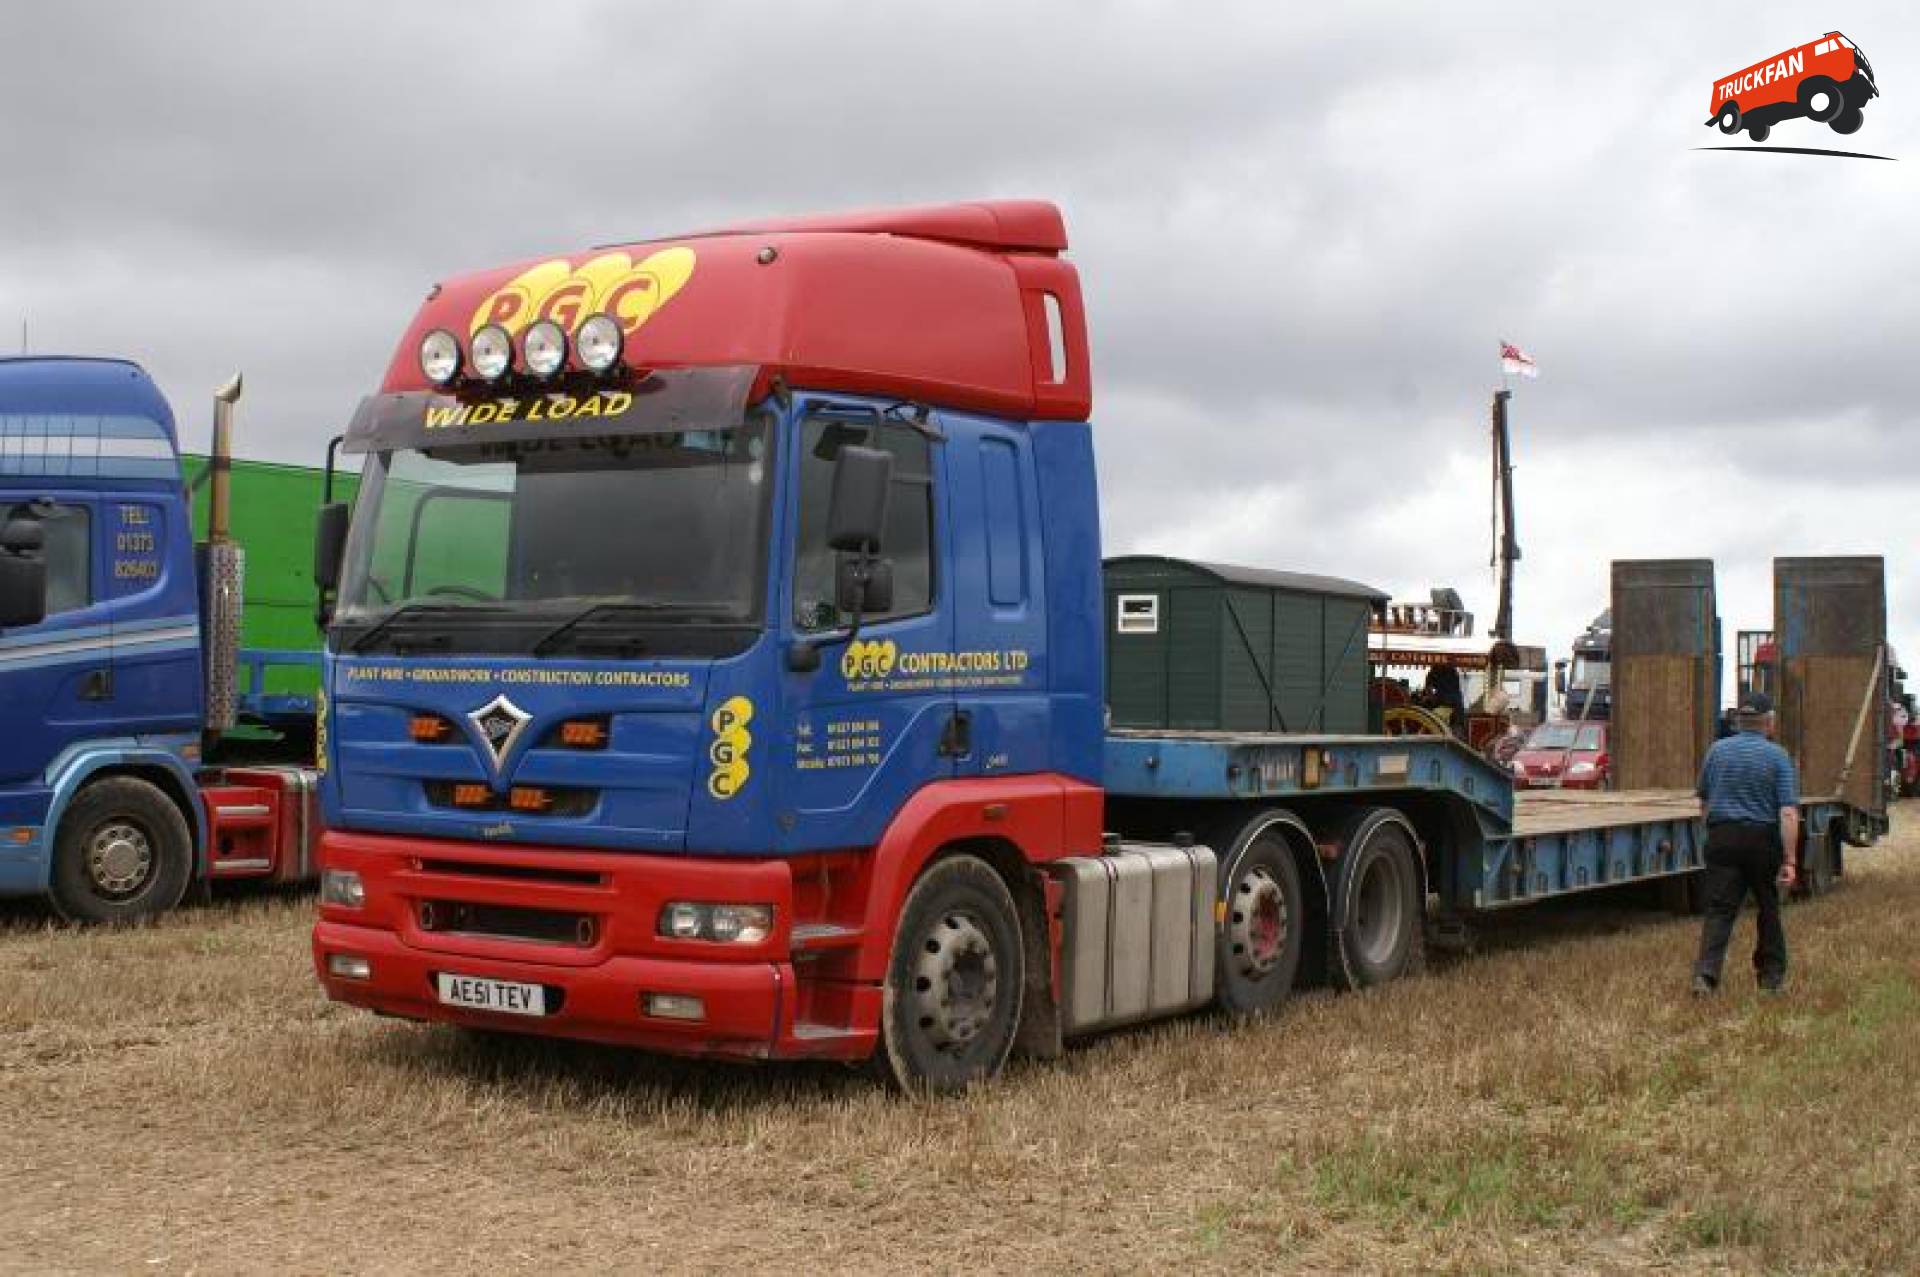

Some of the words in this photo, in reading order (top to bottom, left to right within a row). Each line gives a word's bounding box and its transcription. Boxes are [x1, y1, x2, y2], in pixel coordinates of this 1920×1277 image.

[486, 277, 652, 332] PGC
[425, 399, 518, 428] WIDE
[525, 393, 633, 421] LOAD
[900, 652, 1000, 673] CONTRACTORS
[1003, 650, 1029, 671] LTD
[501, 669, 592, 686] CONSTRUCTION
[595, 671, 690, 687] CONTRACTORS
[450, 978, 492, 1004] AE51
[495, 983, 531, 1009] TEV
